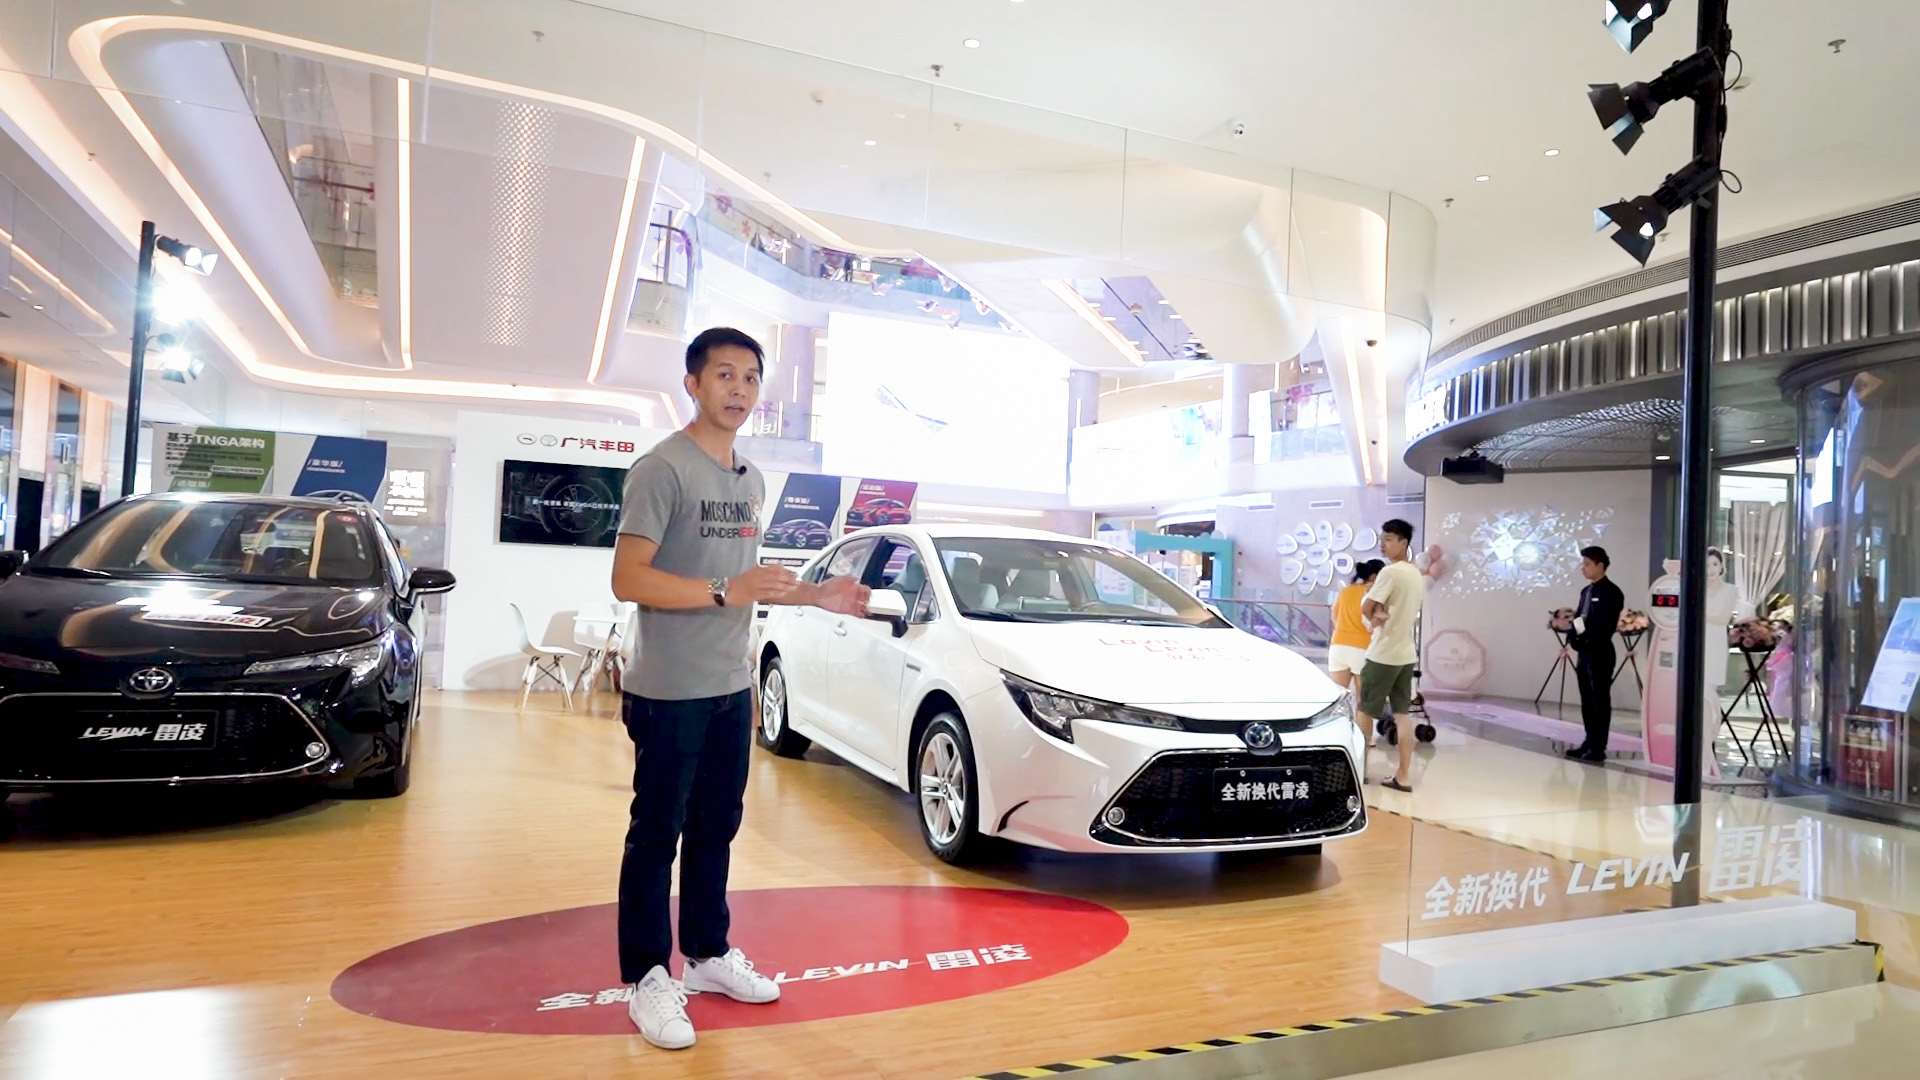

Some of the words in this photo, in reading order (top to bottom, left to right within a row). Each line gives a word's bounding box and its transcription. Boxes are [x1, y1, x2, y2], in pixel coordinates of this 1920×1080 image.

[560, 437, 635, 453] 广汽丰田
[79, 727, 151, 740] LEVIN
[153, 723, 207, 741] 雷凌
[1221, 782, 1310, 801] 全新换代雷凌
[1420, 866, 1552, 920] 全新换代
[1566, 852, 1691, 895] LEVIN
[1707, 822, 1810, 893] 雷凌
[774, 958, 910, 983] LEVIN
[926, 943, 1032, 971] 雷凌
